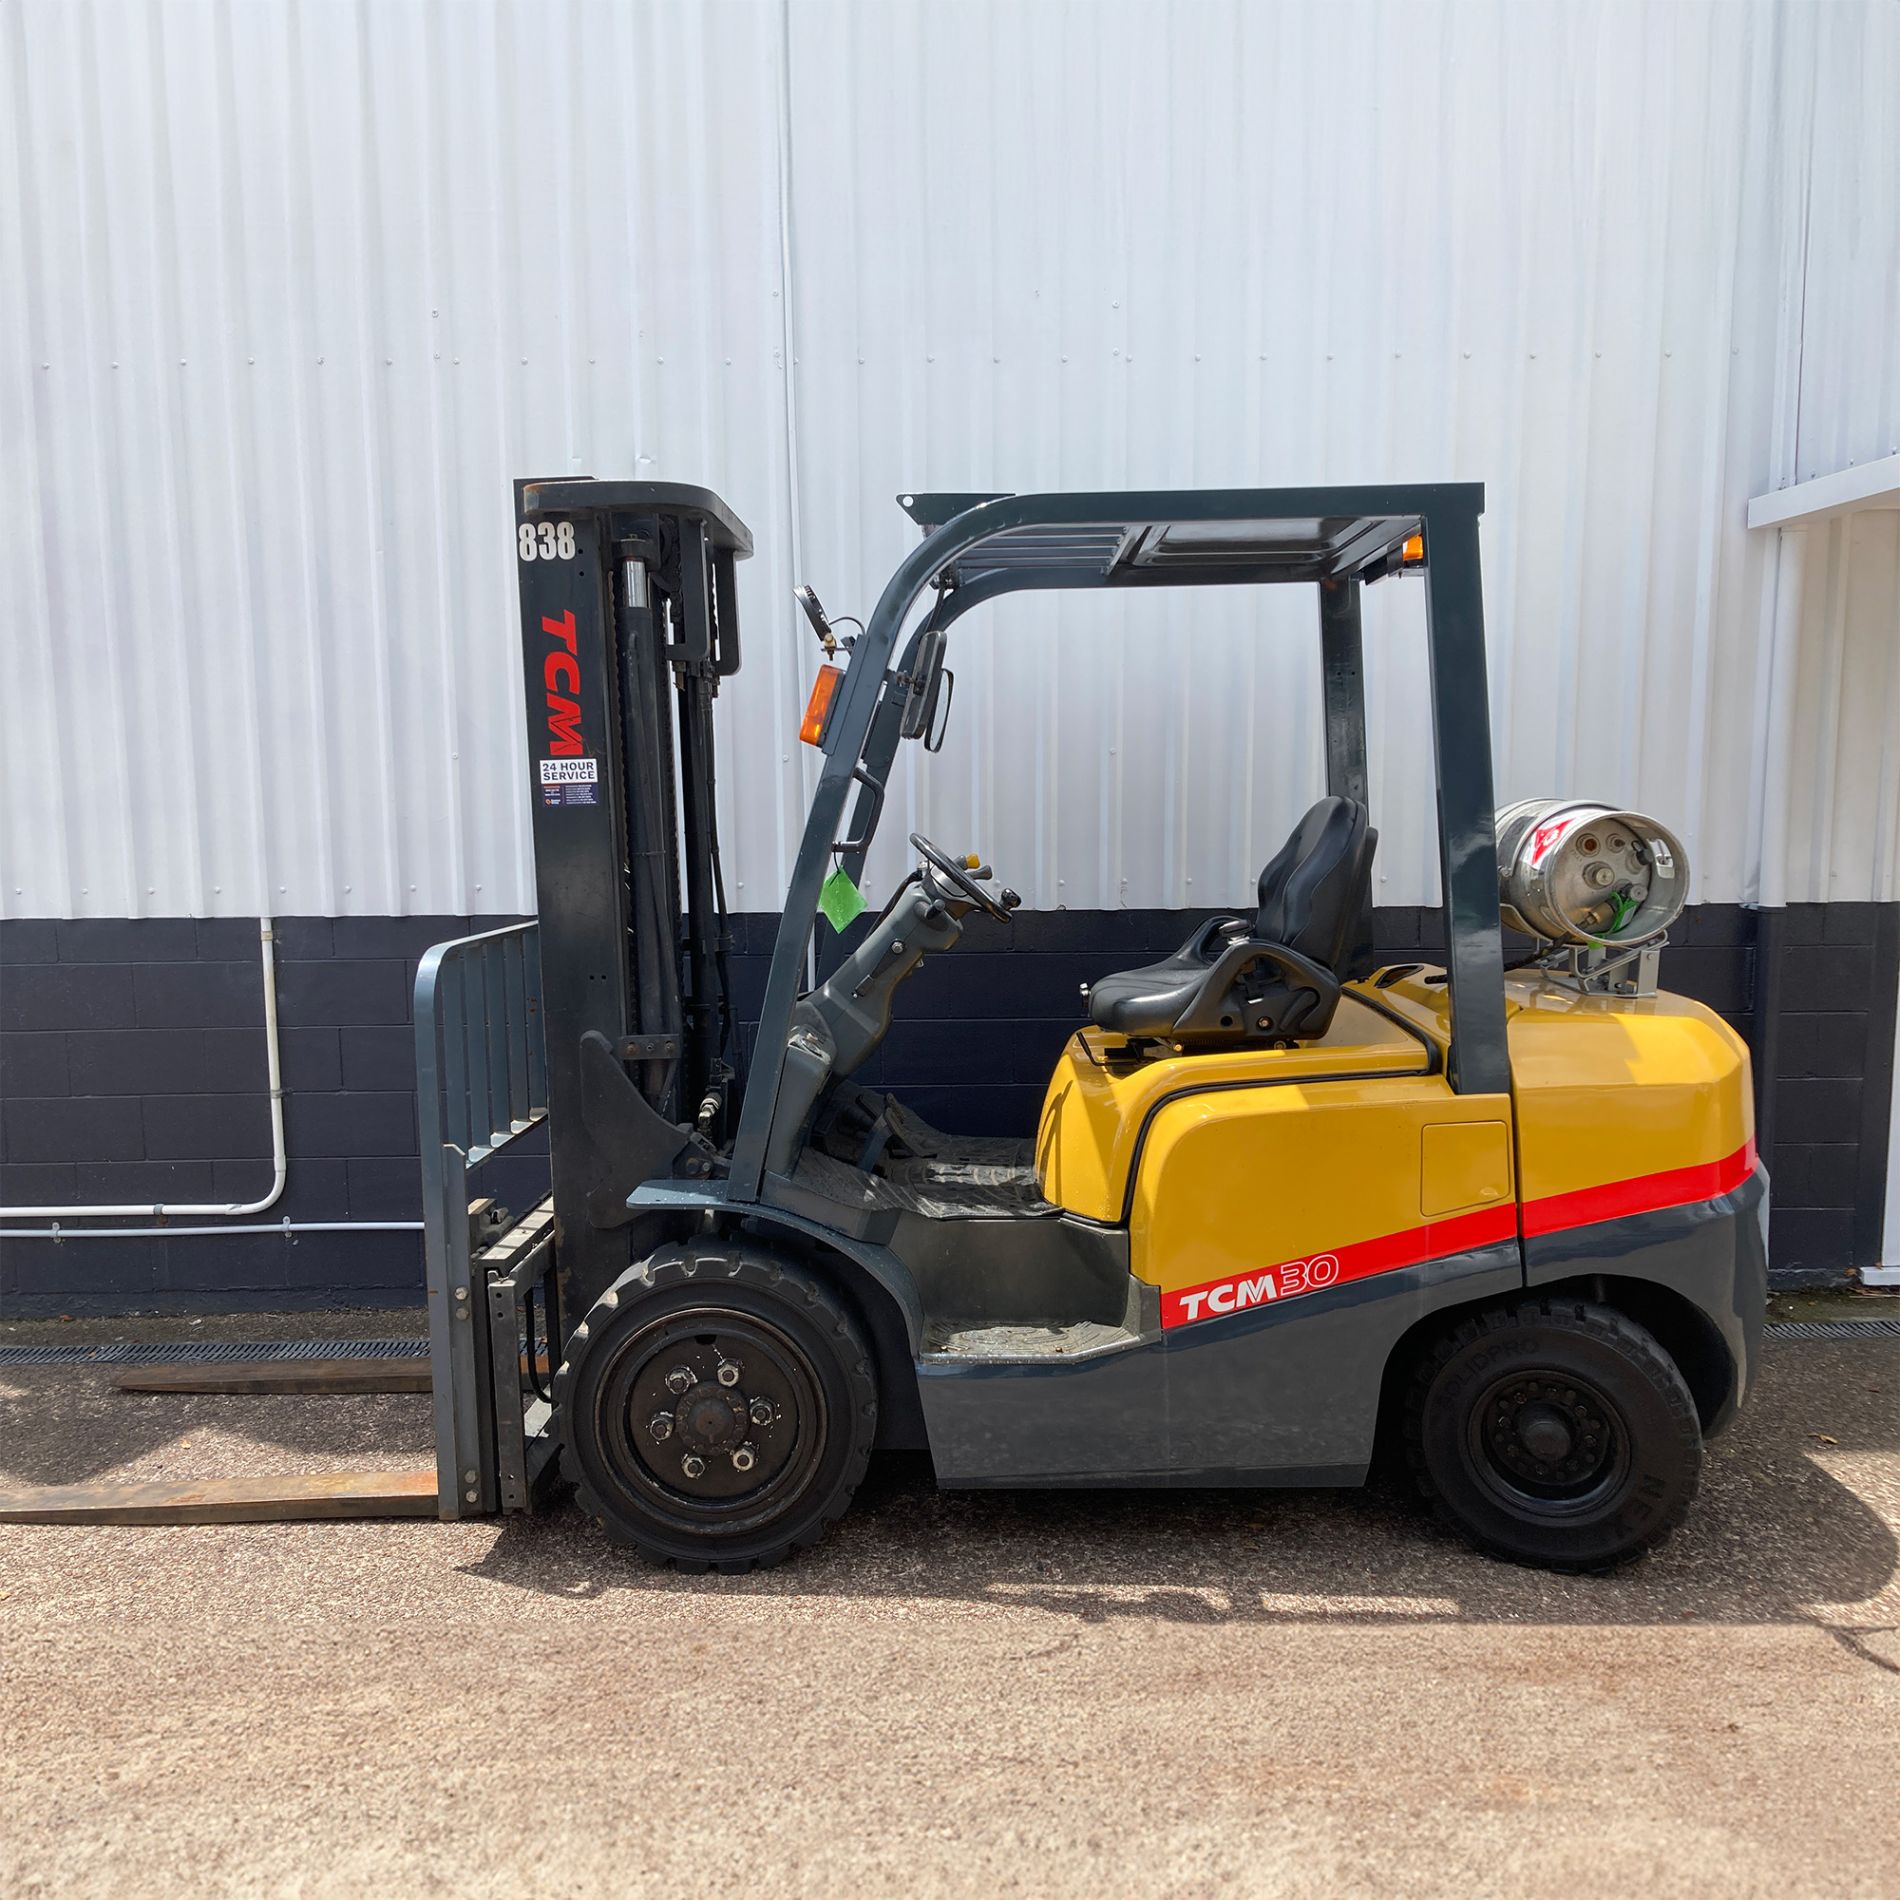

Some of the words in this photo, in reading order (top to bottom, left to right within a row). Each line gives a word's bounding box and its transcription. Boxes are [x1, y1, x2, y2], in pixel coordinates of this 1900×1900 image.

[518, 521, 576, 562] 838
[541, 608, 584, 756] TCM
[542, 763, 557, 772] 24
[560, 762, 594, 771] HOUR
[543, 771, 595, 781] SERVICE
